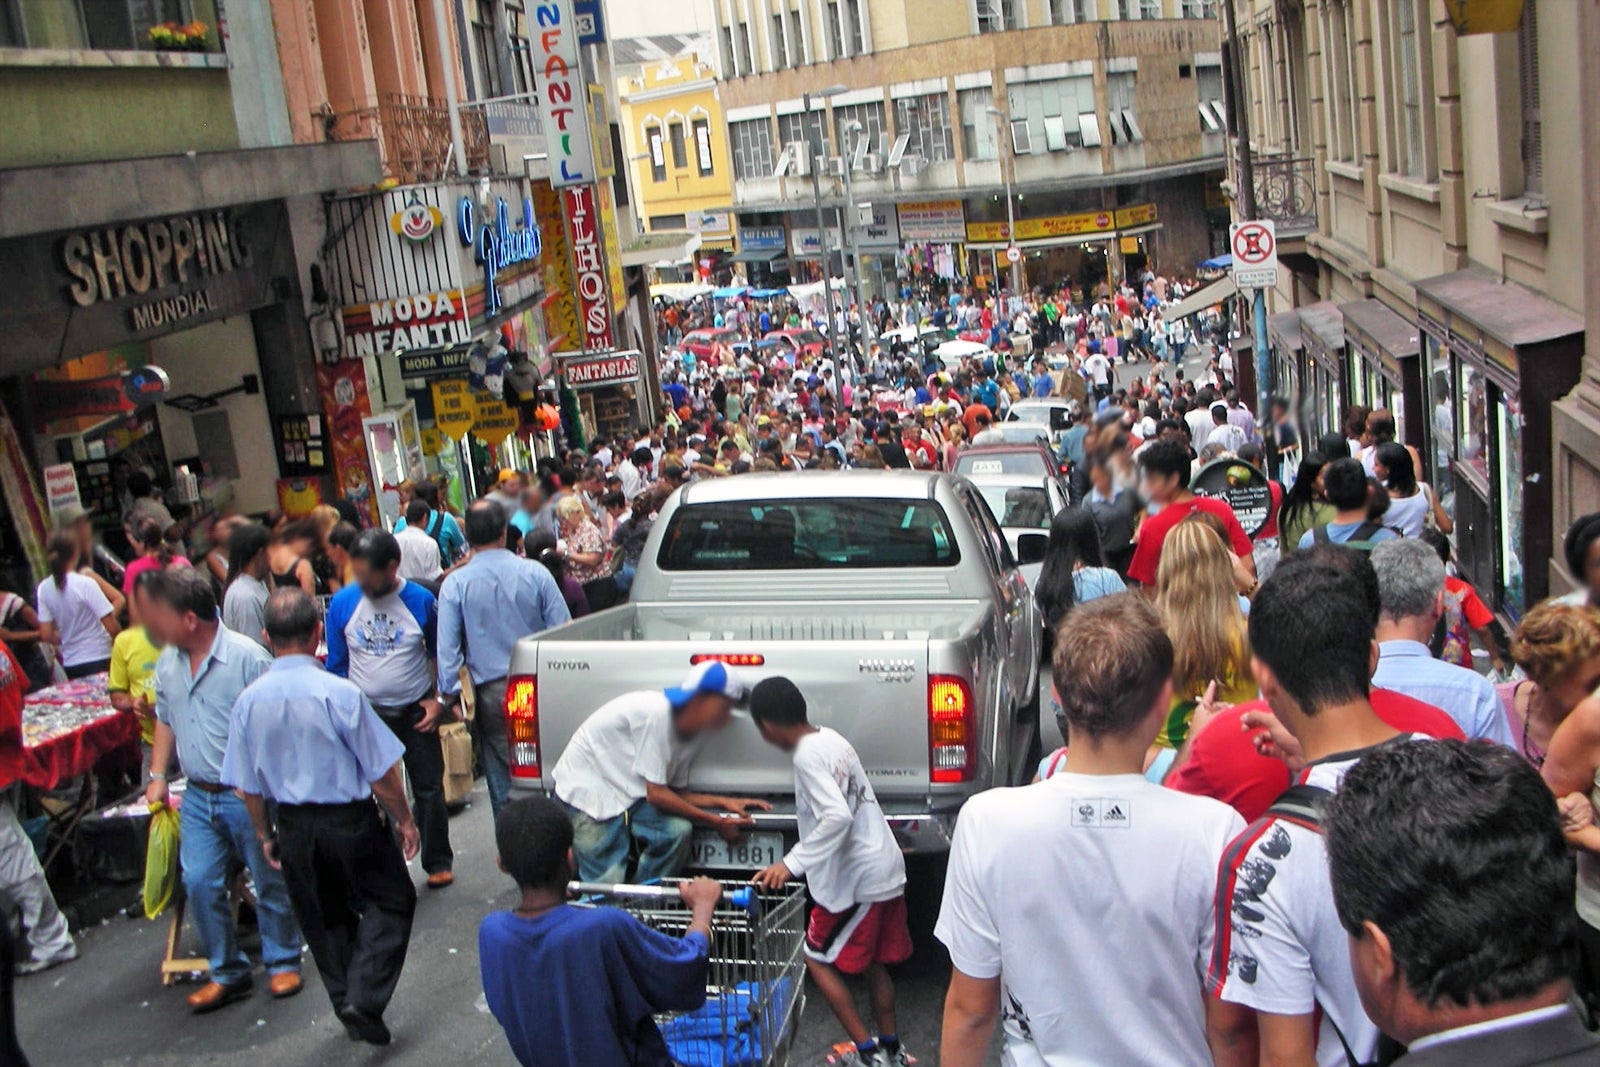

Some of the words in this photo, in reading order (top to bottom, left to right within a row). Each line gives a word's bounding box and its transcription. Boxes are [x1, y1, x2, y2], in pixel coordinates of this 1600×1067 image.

[537, 0, 583, 182] NFANTIL
[65, 208, 251, 307] SHOPPING
[132, 291, 217, 331] MUNDIAL
[369, 292, 456, 327] MODA
[346, 318, 472, 358] INFANTIL
[405, 356, 437, 370] MODA
[567, 359, 637, 383] FANTASIAS
[546, 660, 591, 671] TOYOTA
[859, 659, 916, 672] HILUX
[865, 769, 920, 777] TOMATIC
